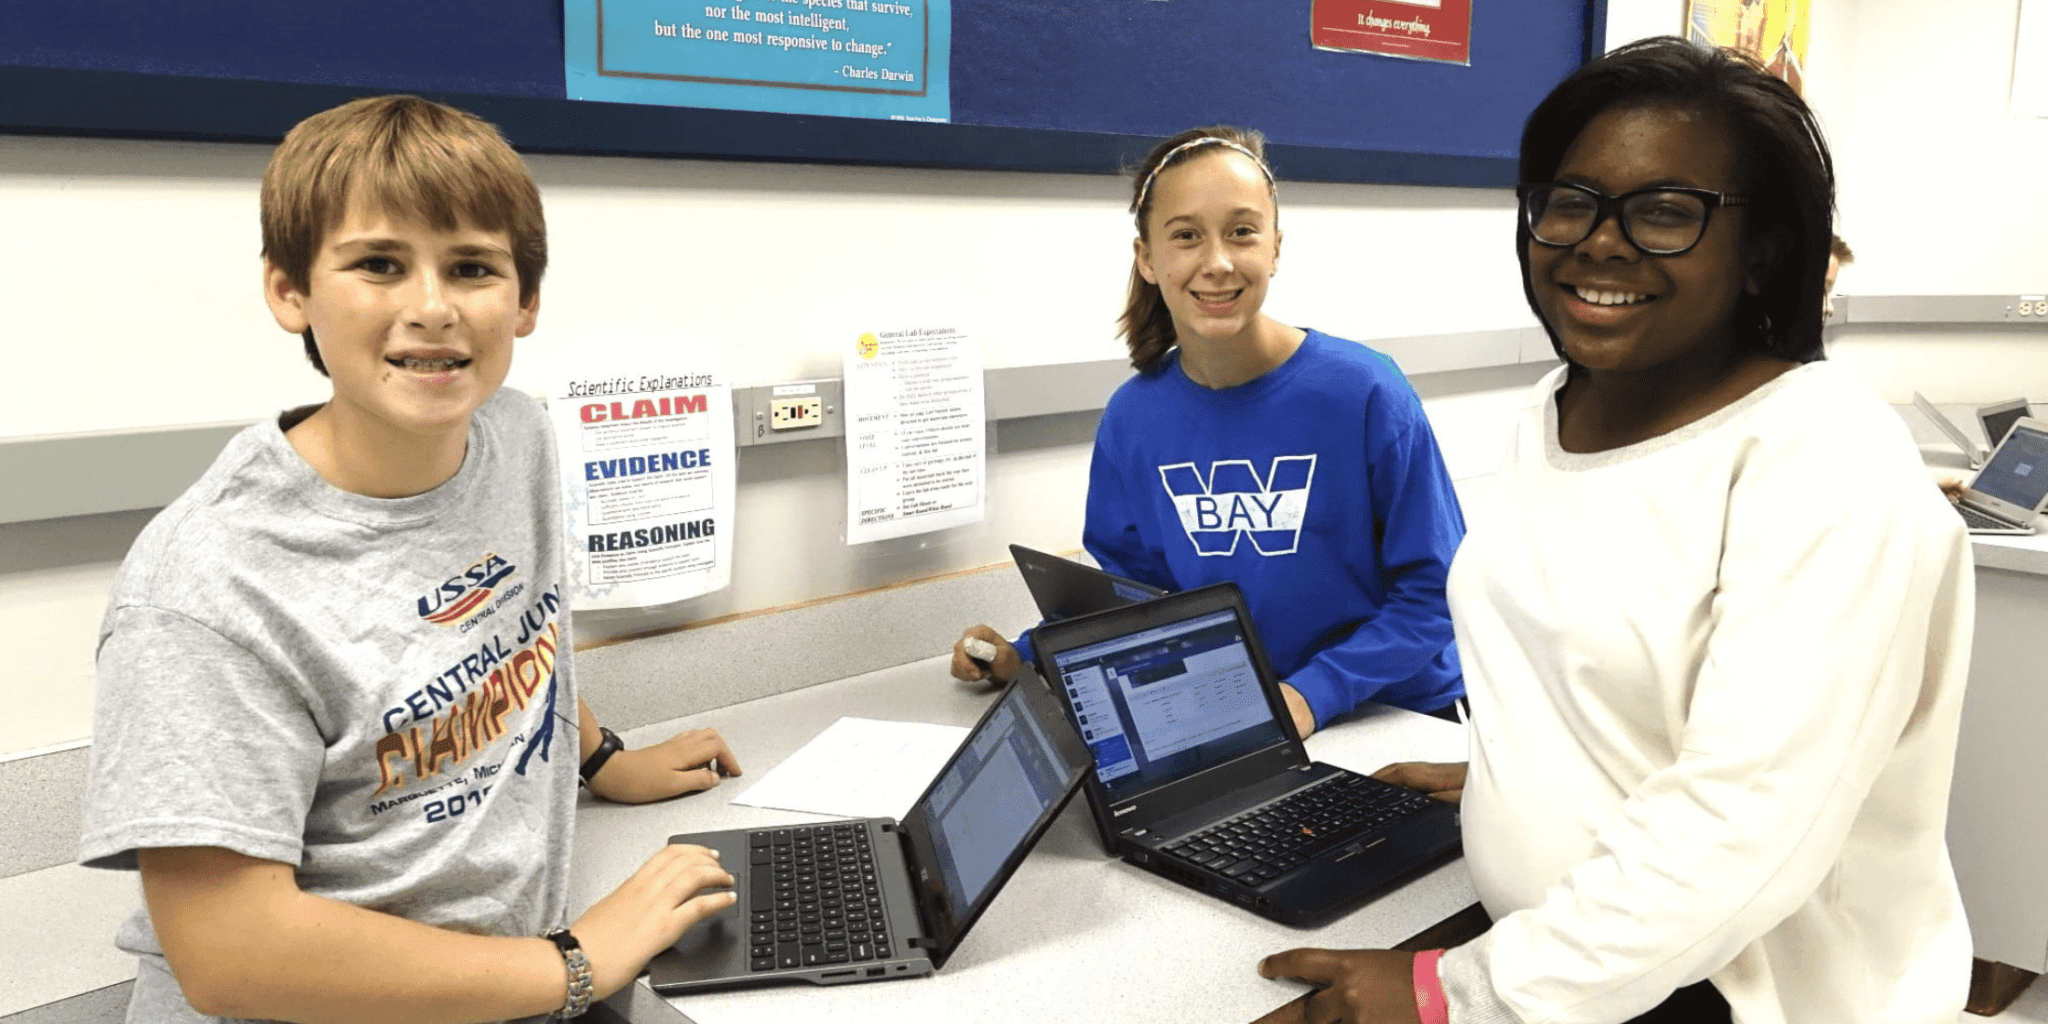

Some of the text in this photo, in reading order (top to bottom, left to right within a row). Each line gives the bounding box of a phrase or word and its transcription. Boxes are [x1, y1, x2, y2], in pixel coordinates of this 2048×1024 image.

[705, 4, 850, 32] nor the most intelligent,
[846, 0, 868, 11] that
[871, 1, 914, 18] survive,
[654, 19, 677, 37] but
[681, 23, 702, 39] the
[706, 29, 729, 41] one
[733, 31, 762, 45] most
[766, 34, 828, 51] responsive
[831, 38, 842, 51] to
[842, 65, 878, 80] Charles
[881, 68, 914, 82] Darwin
[879, 327, 957, 339] General Lab Expectations
[568, 372, 713, 397] Scientific Explanations
[579, 394, 708, 424] CLAIM
[584, 448, 712, 482] EVIDENCE
[1195, 493, 1283, 529] BAY
[588, 517, 716, 553] REASONING
[417, 553, 509, 617] USSA
[459, 583, 525, 634] CENTRAL DIVISION
[382, 635, 512, 734] CENTRAL
